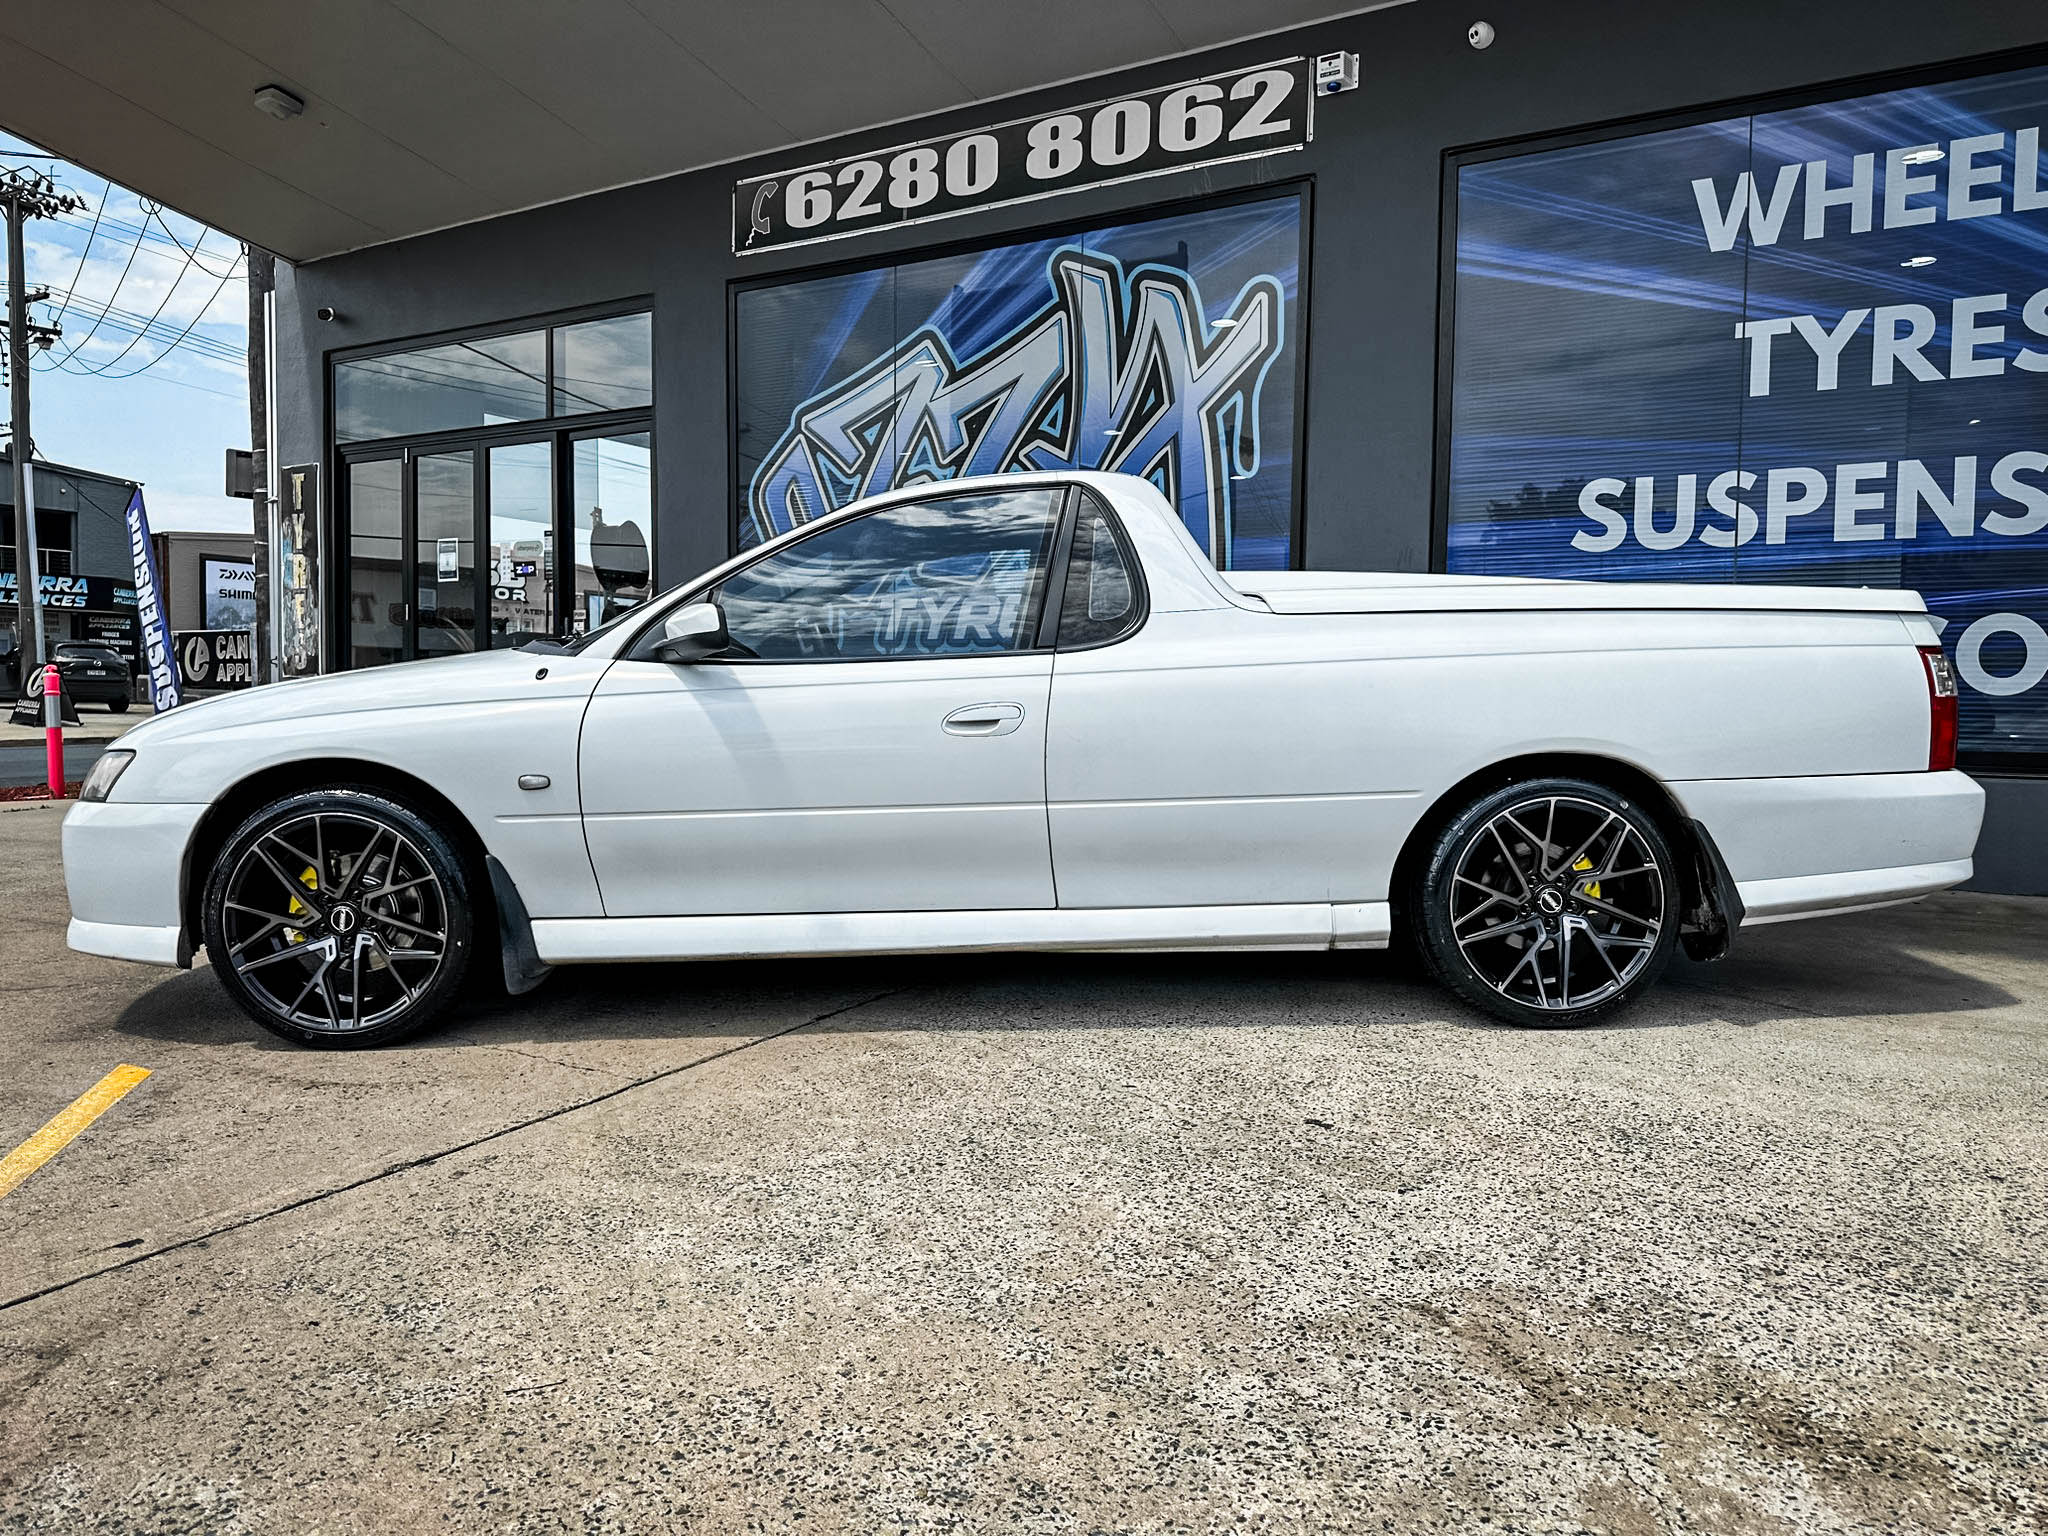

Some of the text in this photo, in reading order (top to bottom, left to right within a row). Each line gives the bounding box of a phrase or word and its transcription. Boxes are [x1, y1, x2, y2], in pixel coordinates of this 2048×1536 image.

[785, 69, 1296, 229] 6280 8062
[1570, 450, 2048, 553] SUSPENS
[215, 634, 252, 660] CAN
[1925, 612, 2048, 696] O
